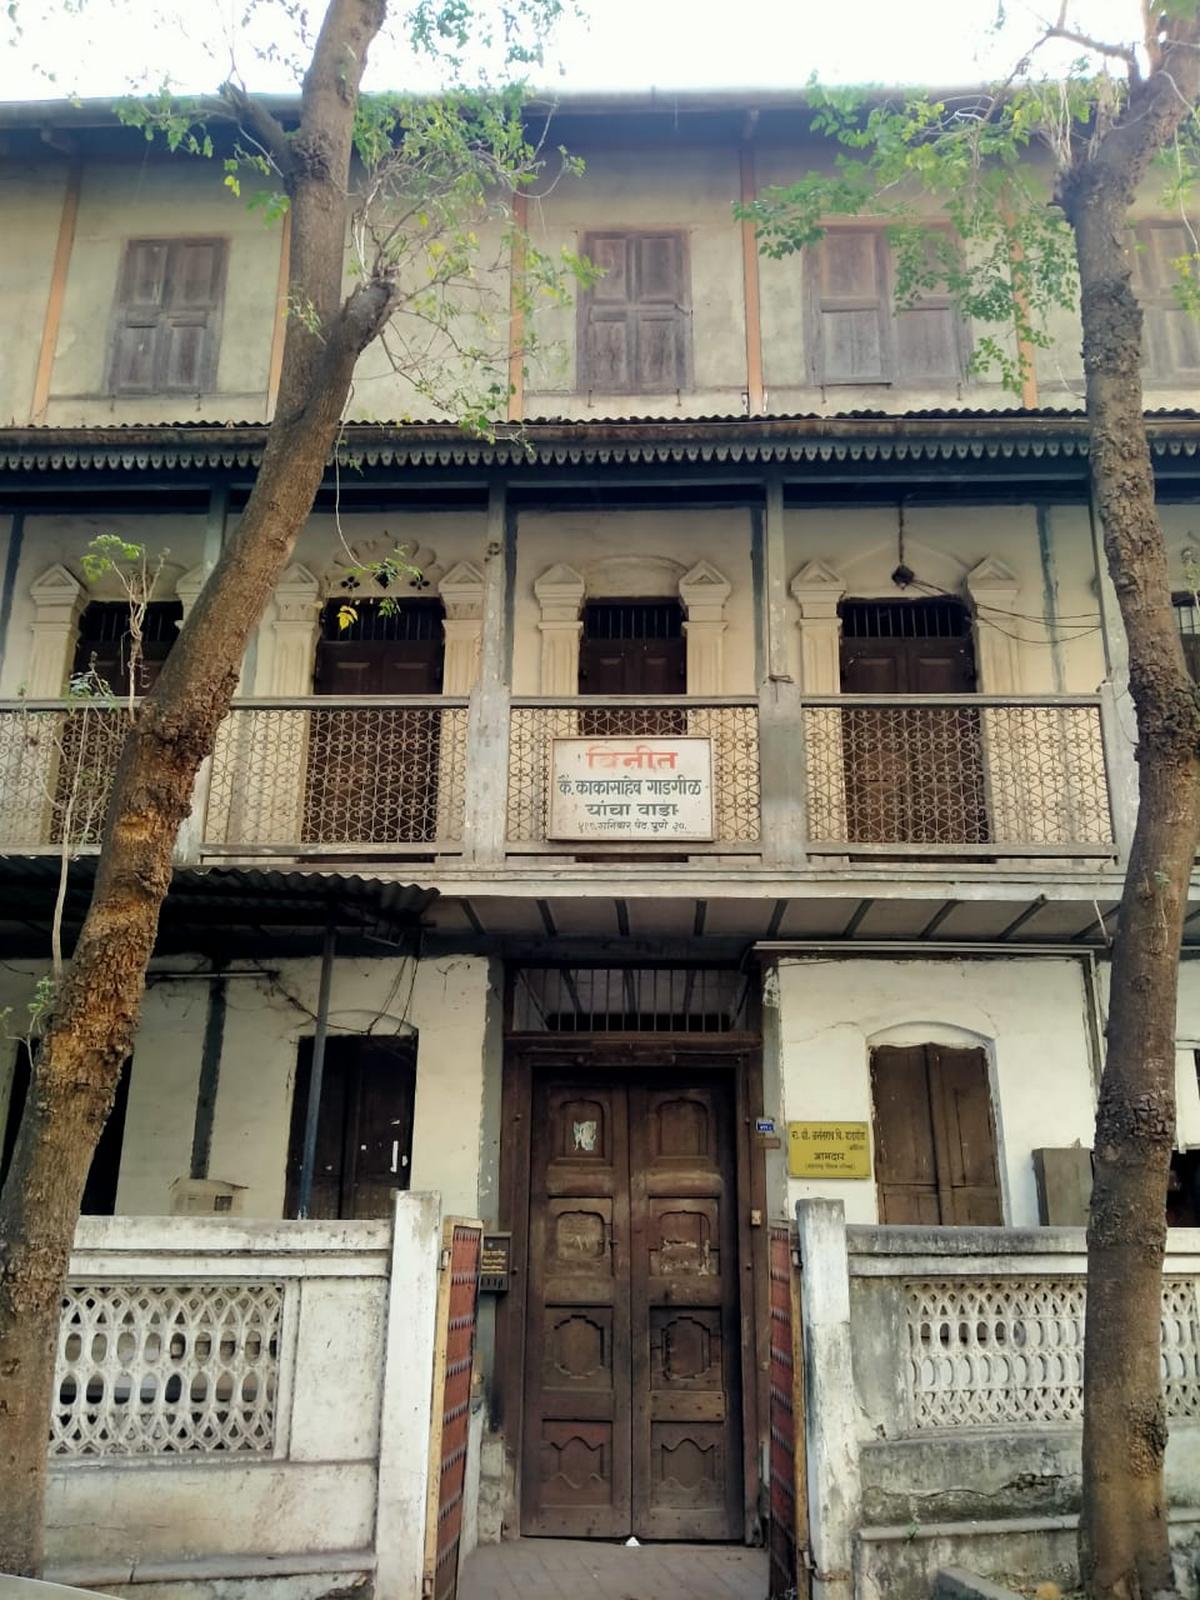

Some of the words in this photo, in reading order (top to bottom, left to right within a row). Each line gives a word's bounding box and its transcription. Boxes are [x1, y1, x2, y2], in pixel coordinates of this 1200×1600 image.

[645, 774, 702, 796] गाडगीळ
[585, 800, 631, 817] यांचा
[637, 803, 679, 817] वाडा
